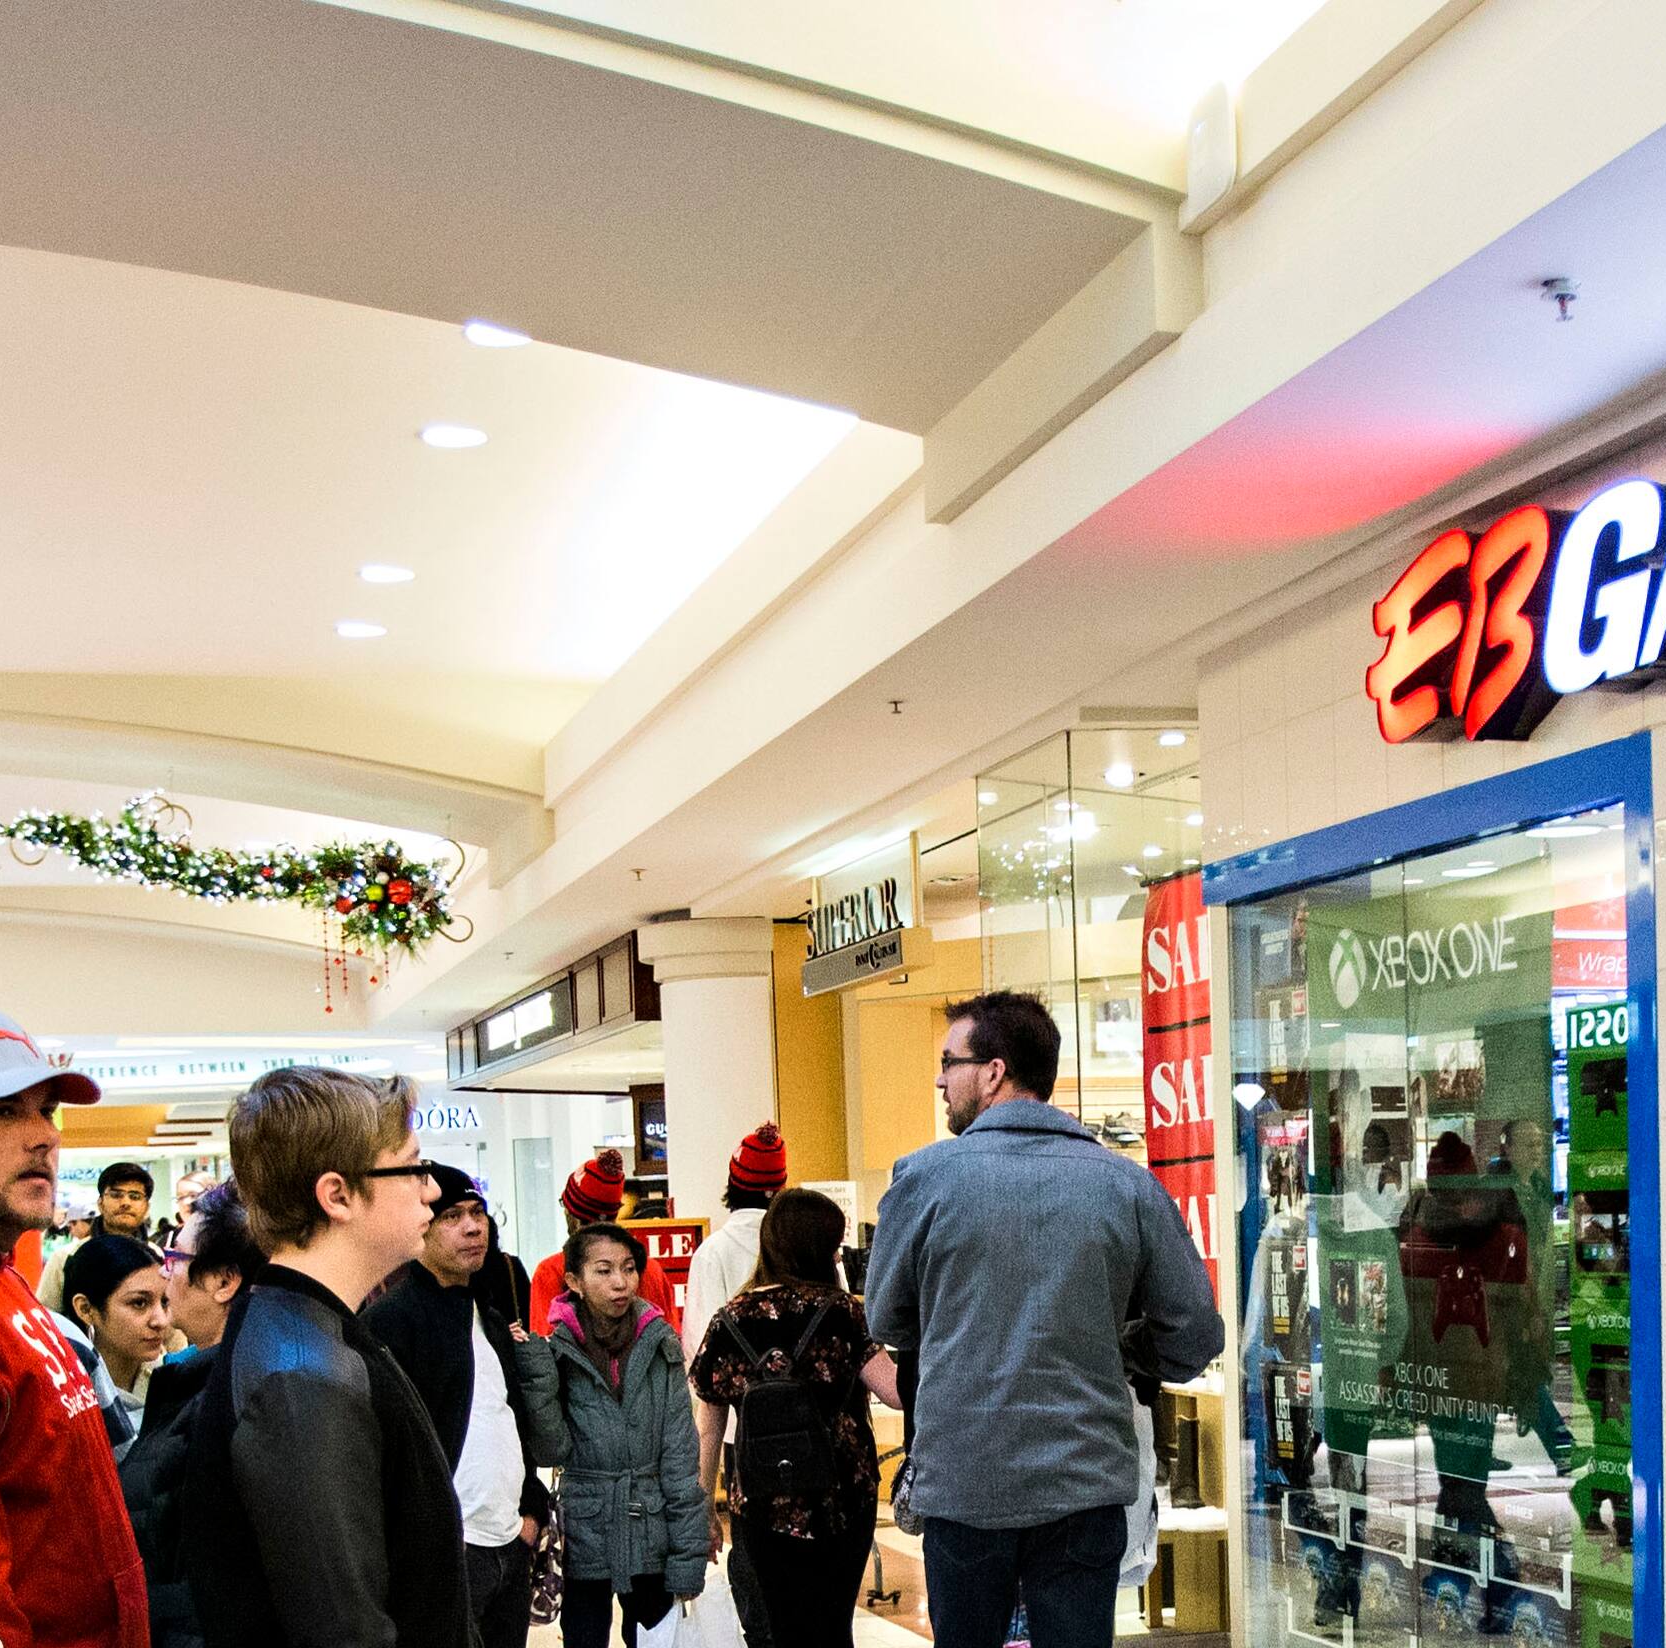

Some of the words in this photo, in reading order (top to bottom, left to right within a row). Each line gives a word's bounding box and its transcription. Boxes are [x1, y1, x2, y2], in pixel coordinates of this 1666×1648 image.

[1366, 503, 1549, 742] EB
[1369, 928, 1451, 991] XBOX
[1448, 915, 1518, 979] ONE
[1395, 1388, 1429, 1414] CREED
[1432, 1395, 1466, 1418] UNITY
[1424, 1365, 1450, 1390] ONE
